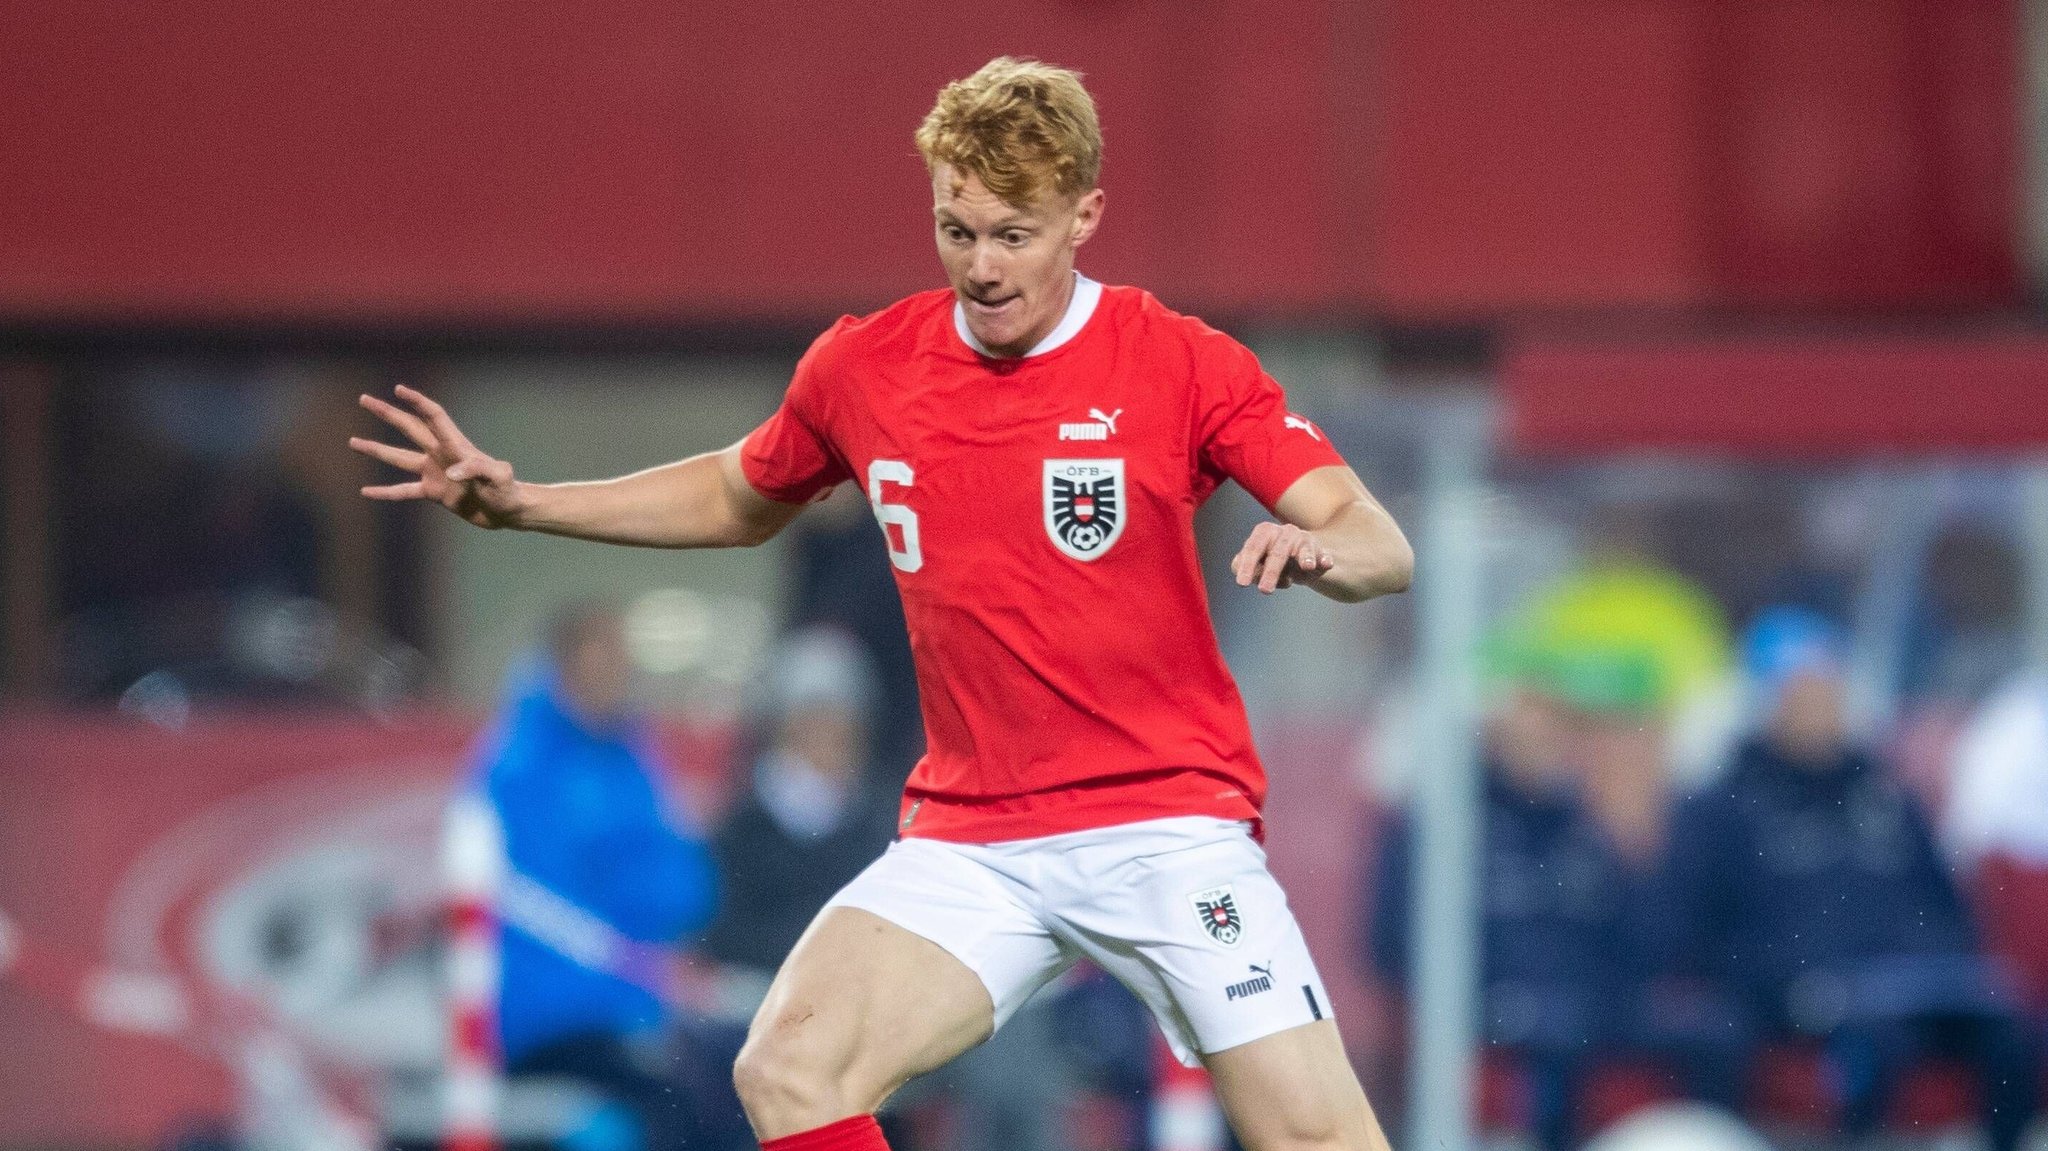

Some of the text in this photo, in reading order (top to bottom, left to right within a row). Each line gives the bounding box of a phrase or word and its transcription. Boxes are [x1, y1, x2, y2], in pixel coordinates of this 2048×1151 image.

[1059, 423, 1107, 440] PUMA
[868, 459, 923, 573] 6
[1225, 976, 1271, 1001] PUMA
